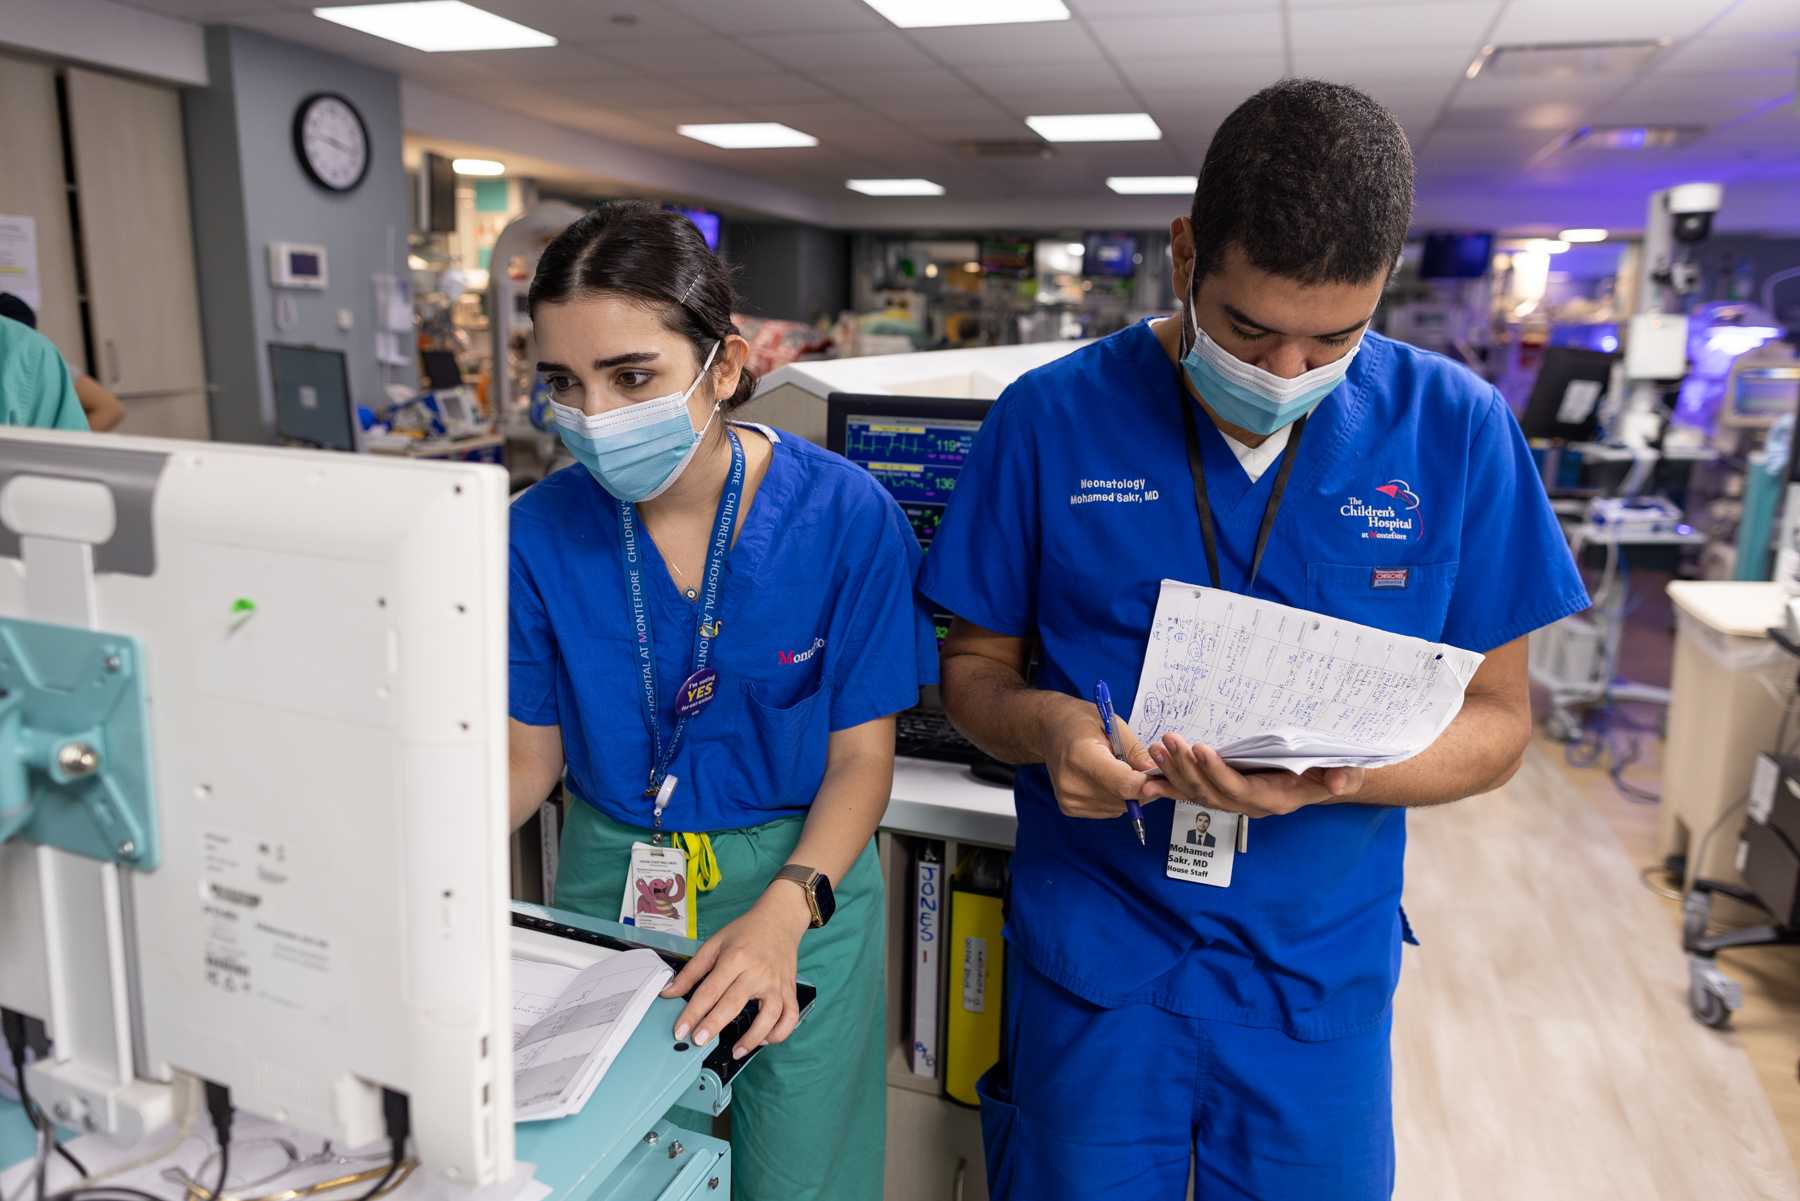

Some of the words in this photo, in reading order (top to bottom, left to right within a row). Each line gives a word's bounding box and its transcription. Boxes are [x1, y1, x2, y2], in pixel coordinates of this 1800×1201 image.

[1080, 478, 1146, 490] Neonatology
[1070, 492, 1114, 505] Mohamed
[1116, 492, 1143, 503] Sakr,
[1144, 490, 1159, 501] MD
[1348, 496, 1362, 505] The
[1340, 505, 1396, 518] Children's
[713, 492, 737, 557] CHILDREN'S
[1368, 516, 1412, 531] Hospital
[704, 557, 721, 611] HOSPITAL
[630, 569, 648, 643] MONTEFIORE
[640, 645, 650, 659] AT
[687, 682, 713, 703] YES
[1169, 843, 1214, 858] Mohamed
[1192, 858, 1209, 868] MD
[1167, 865, 1189, 875] House
[1190, 869, 1209, 878] Staff
[918, 865, 938, 942] JONES
